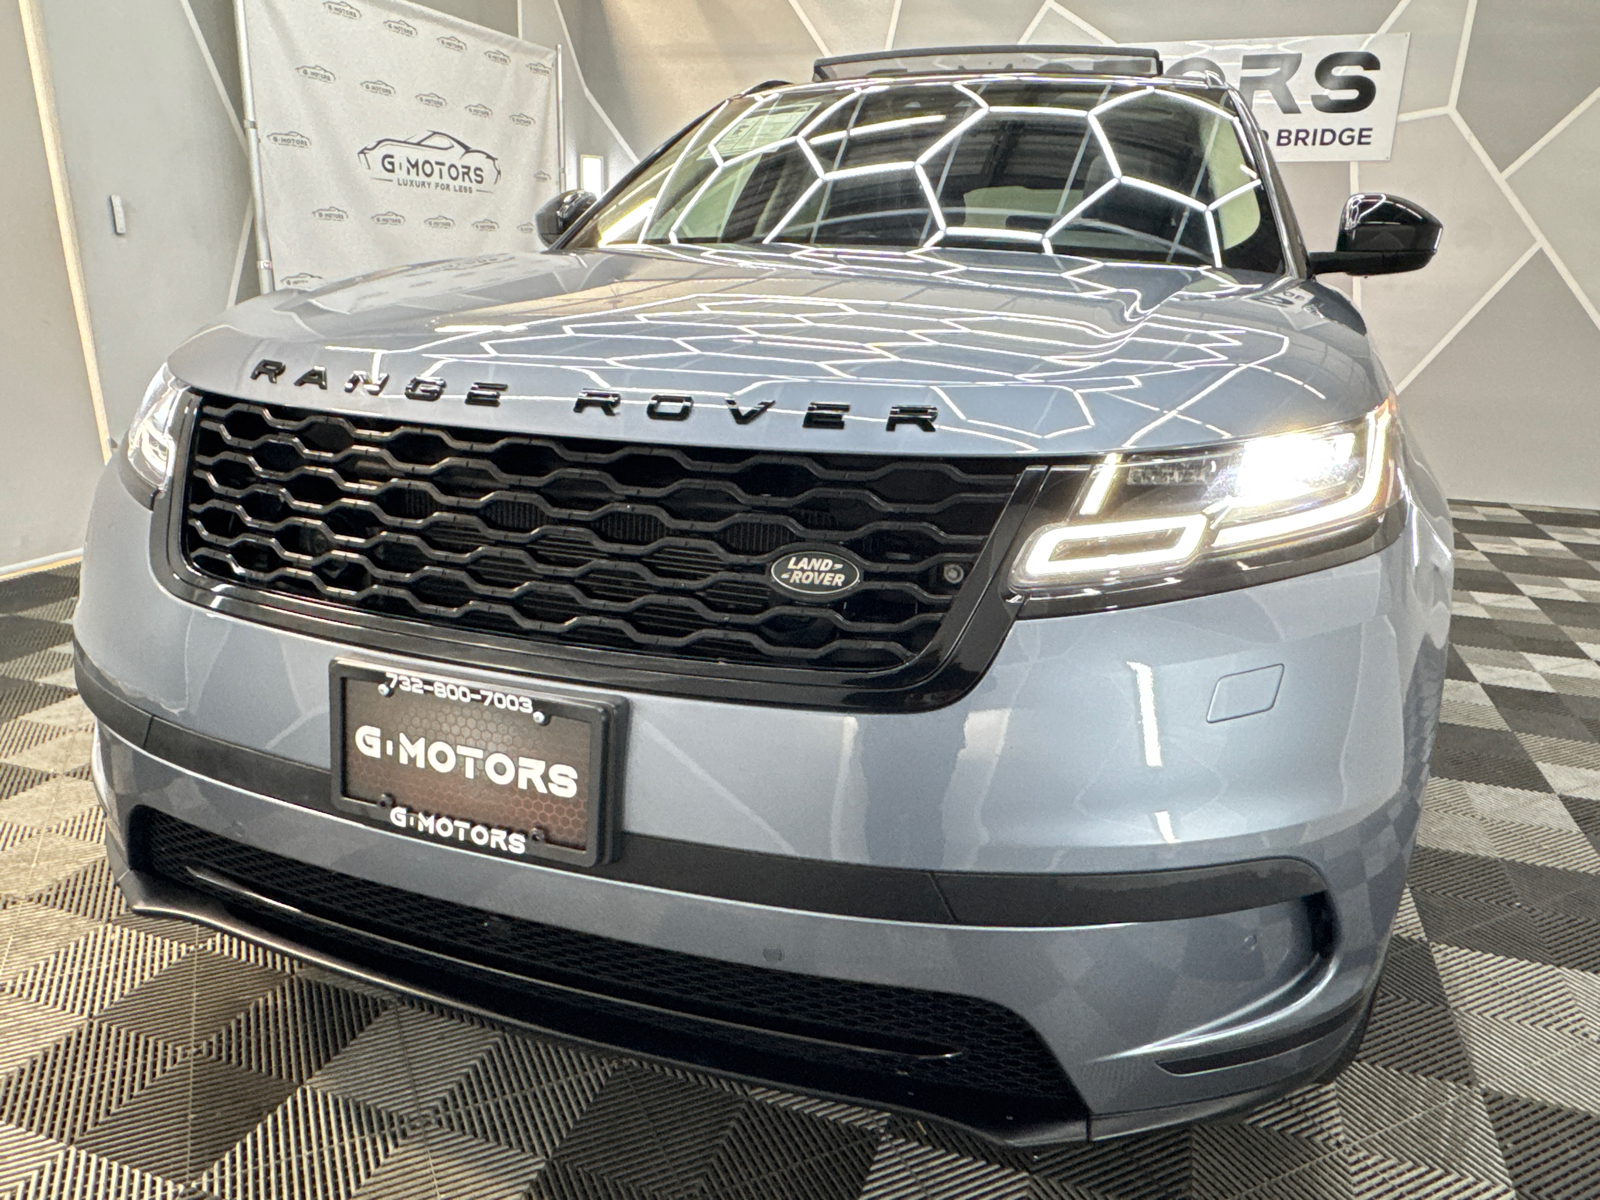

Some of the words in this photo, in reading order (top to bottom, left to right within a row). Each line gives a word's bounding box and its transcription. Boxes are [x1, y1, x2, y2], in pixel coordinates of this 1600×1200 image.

[1276, 127, 1373, 147] BRIDGE
[397, 178, 432, 190] LUXURY
[434, 182, 451, 192] FOR
[453, 185, 473, 194] LESS
[250, 359, 508, 407] RANGE
[573, 388, 938, 432] ROVER
[789, 570, 845, 587] ROVER
[386, 672, 533, 714] 732-800-7003
